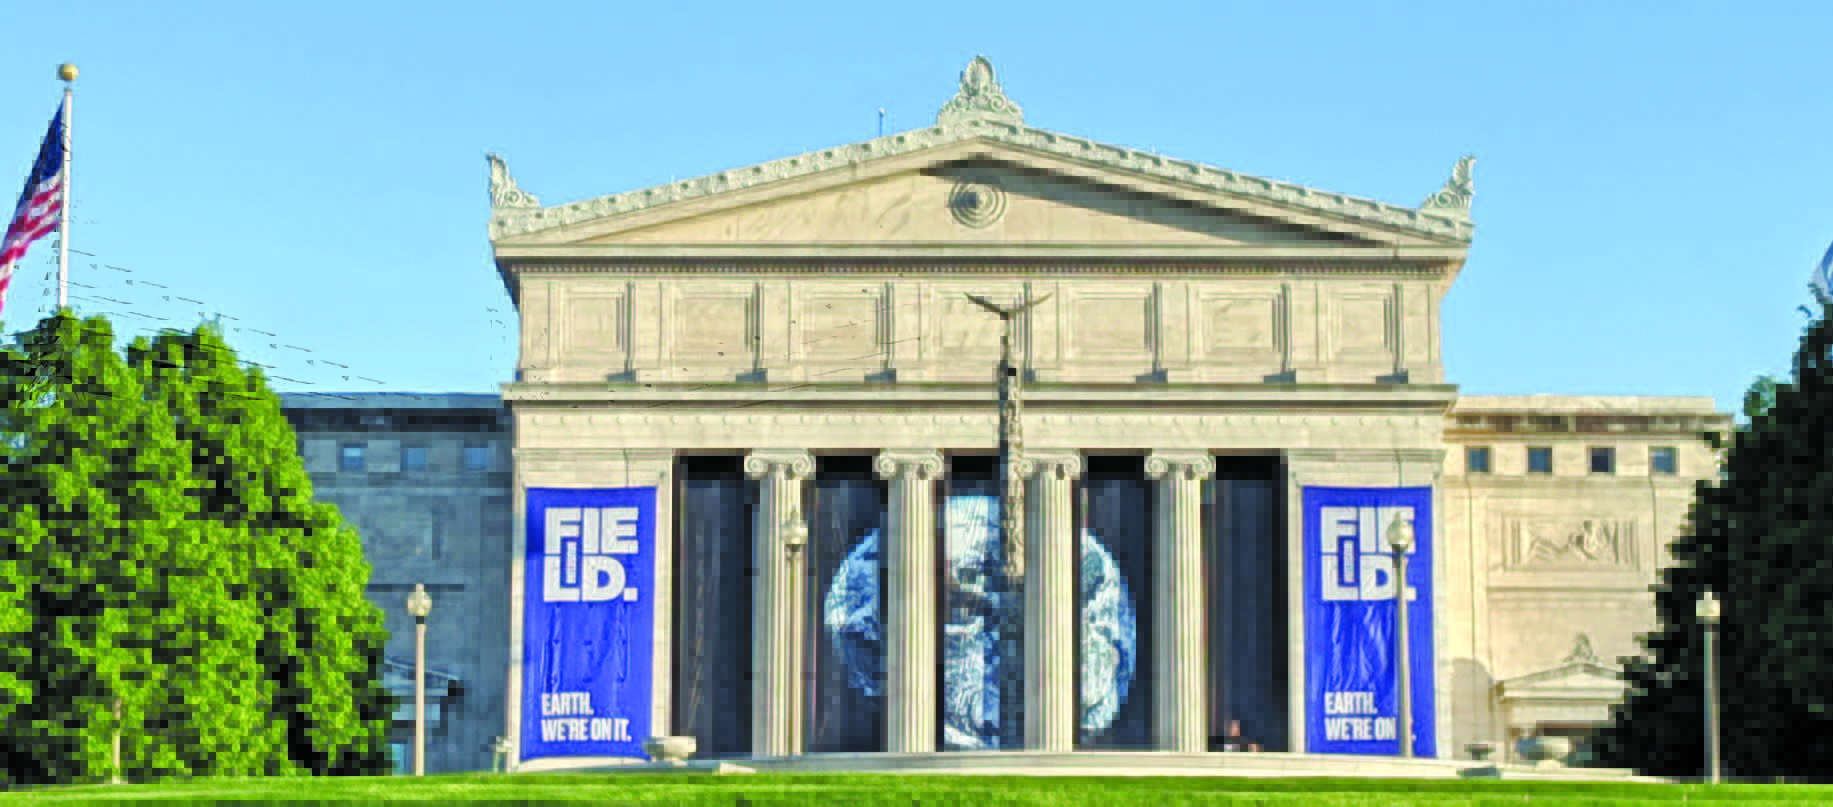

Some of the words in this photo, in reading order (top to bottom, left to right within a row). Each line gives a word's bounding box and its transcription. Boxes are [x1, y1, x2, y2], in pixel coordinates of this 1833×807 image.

[544, 507, 639, 554] FIE
[541, 692, 594, 716] EARTH.
[1324, 691, 1378, 715] EARTH.
[541, 718, 588, 742] WE'RE
[591, 717, 612, 741] ON
[614, 717, 632, 742] IT.
[1324, 717, 1372, 741] WE'RE
[1375, 717, 1396, 741] ON
